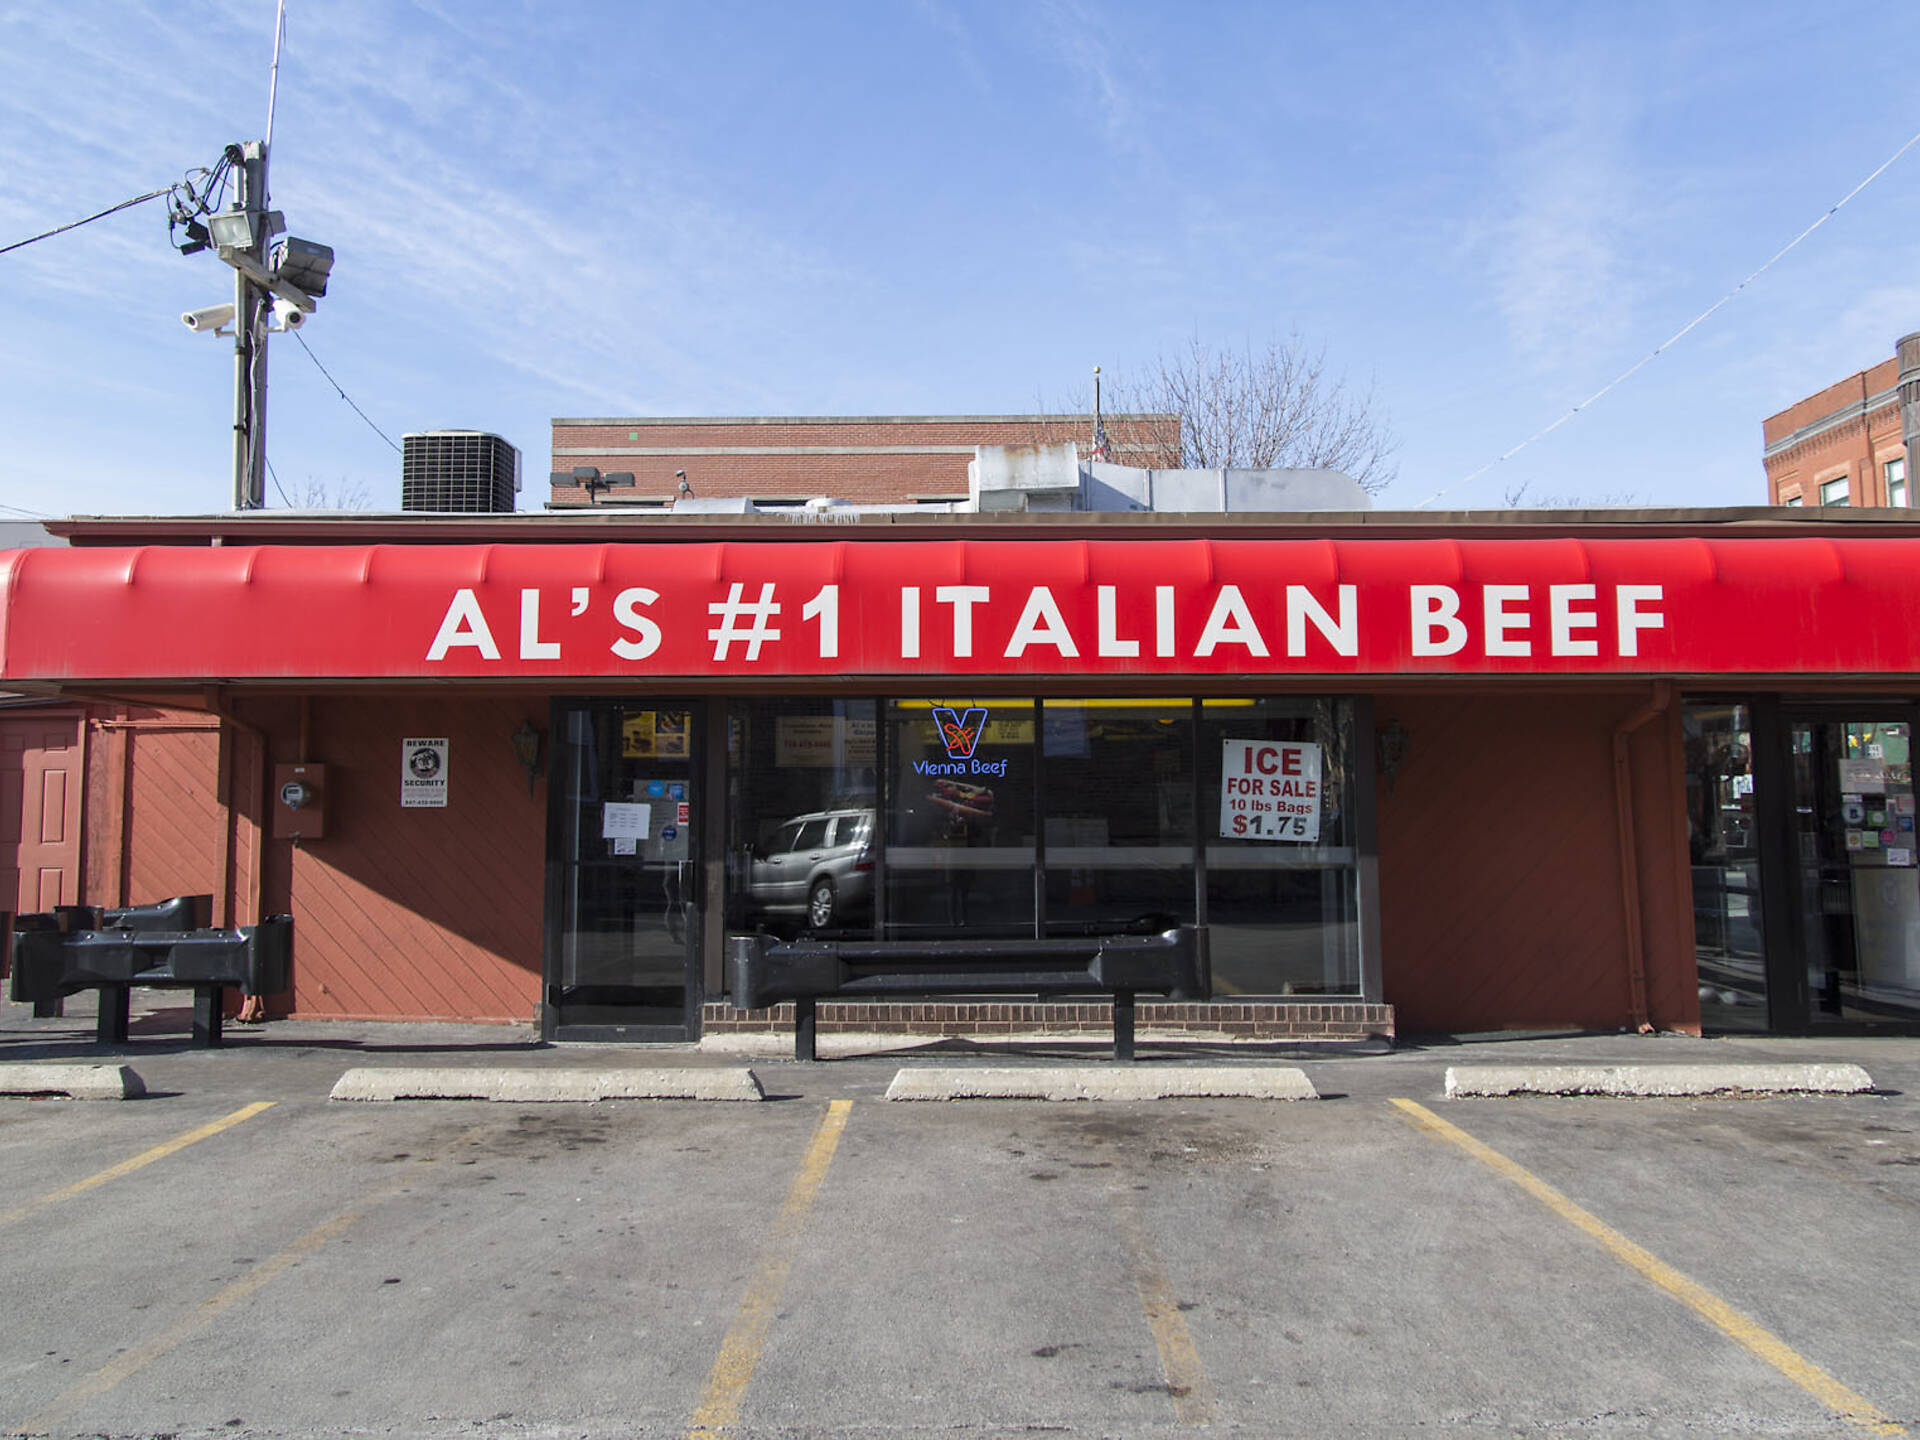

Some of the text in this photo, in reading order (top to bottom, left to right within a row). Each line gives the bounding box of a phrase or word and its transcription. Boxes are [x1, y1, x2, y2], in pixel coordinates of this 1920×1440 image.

[425, 582, 1664, 661] AL'S #1 ITALIAN BEEF
[912, 758, 1009, 777] Vienna Beef
[1244, 746, 1303, 776] ICE
[1227, 777, 1317, 798] FOR SALE
[1229, 798, 1313, 816] 10 lbs Bags
[1231, 813, 1308, 837] $1.75
